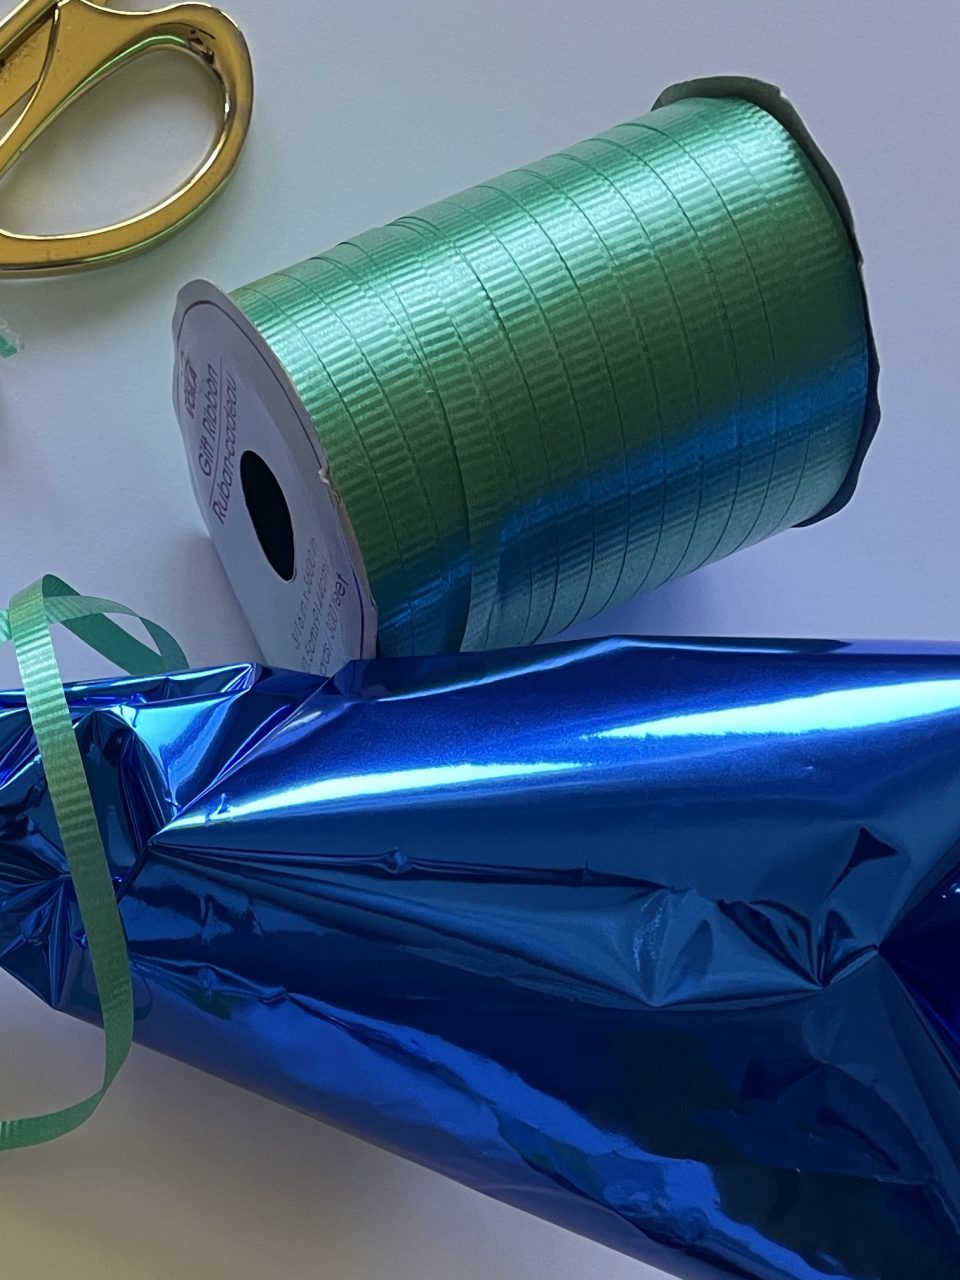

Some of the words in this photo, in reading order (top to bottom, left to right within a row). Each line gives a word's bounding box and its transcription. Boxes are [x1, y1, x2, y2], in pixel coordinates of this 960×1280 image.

[202, 363, 219, 437] Ribbon
[198, 435, 215, 477] Gift
[211, 370, 238, 525] Ruban-cadeau
